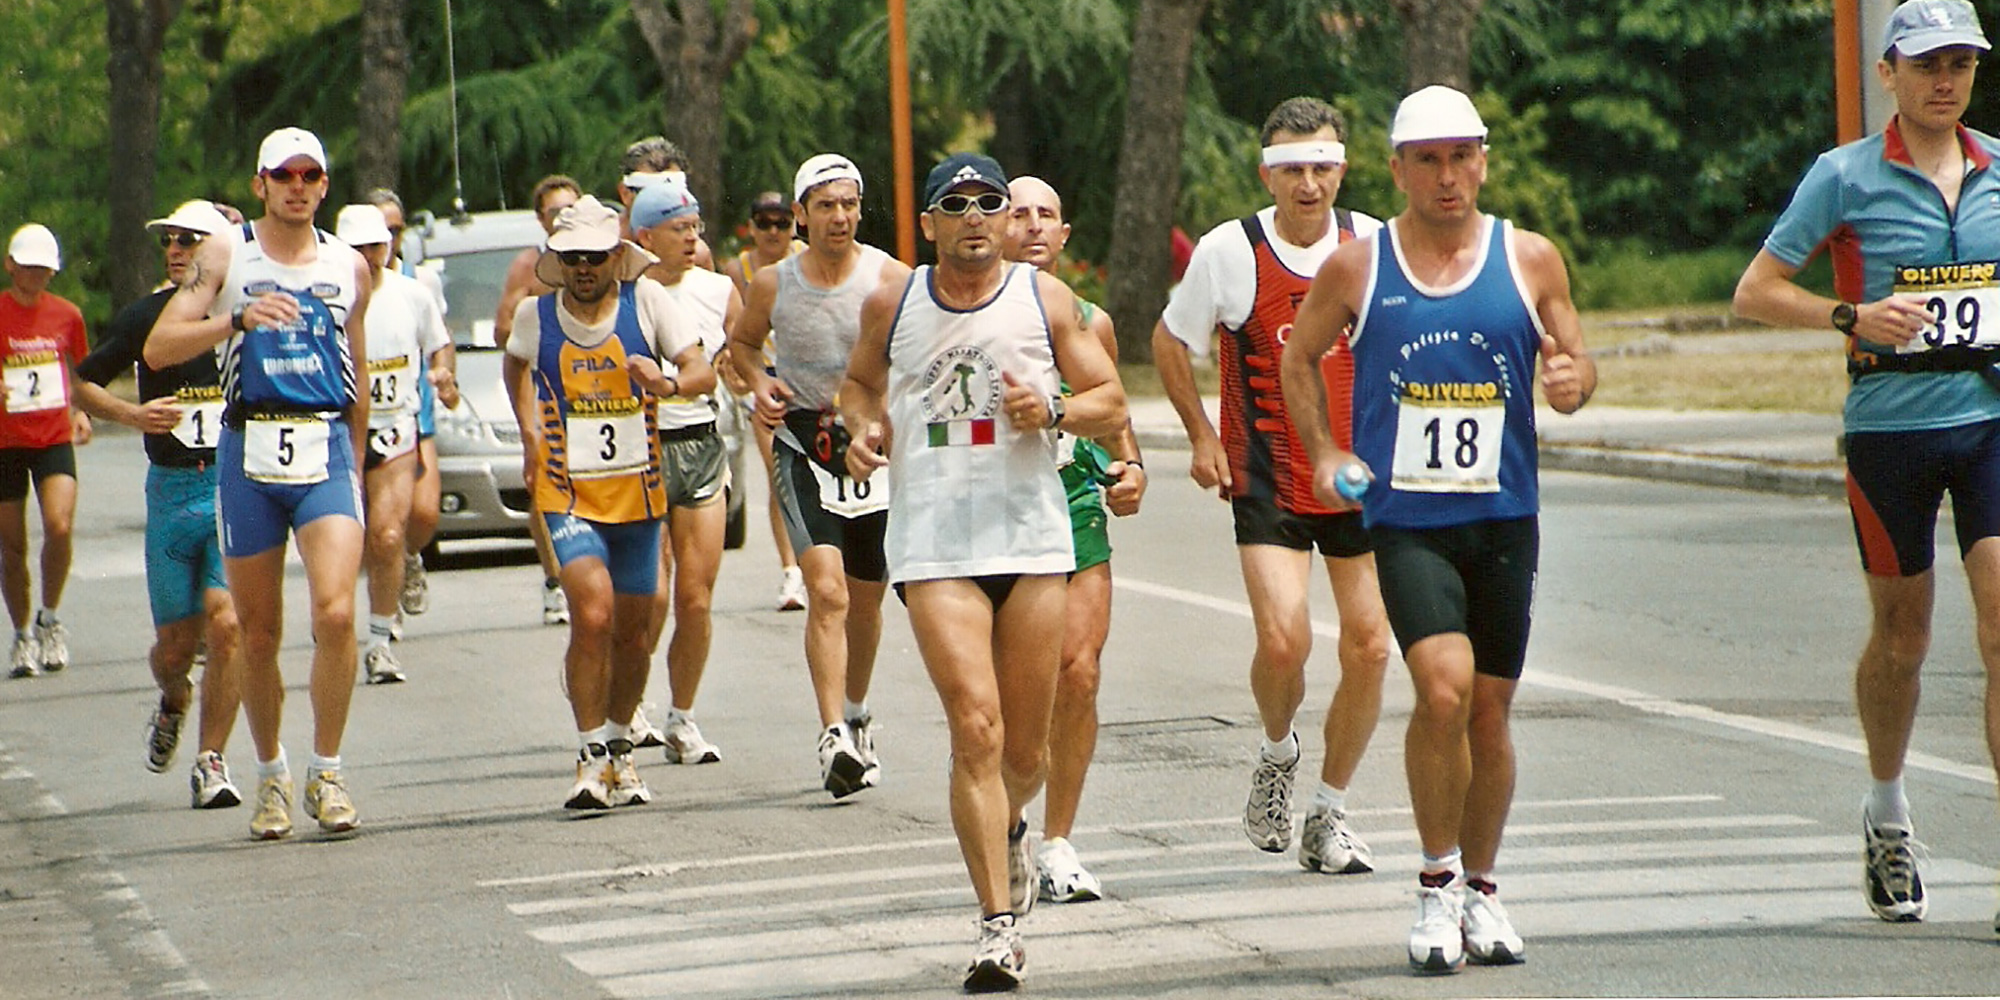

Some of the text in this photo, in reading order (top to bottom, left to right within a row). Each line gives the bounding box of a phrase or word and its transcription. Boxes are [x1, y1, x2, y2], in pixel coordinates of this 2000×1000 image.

[1902, 263, 1996, 284] OLIVIERO
[1923, 296, 1980, 347] 39
[572, 356, 617, 374] FILA
[924, 360, 943, 389] UPER
[28, 371, 40, 397] 2
[371, 375, 397, 403] 43
[1408, 381, 1498, 402] OLIVIERO
[192, 409, 205, 445] 1
[278, 428, 294, 466] 5
[600, 423, 616, 461] 3
[1424, 417, 1479, 469] 18
